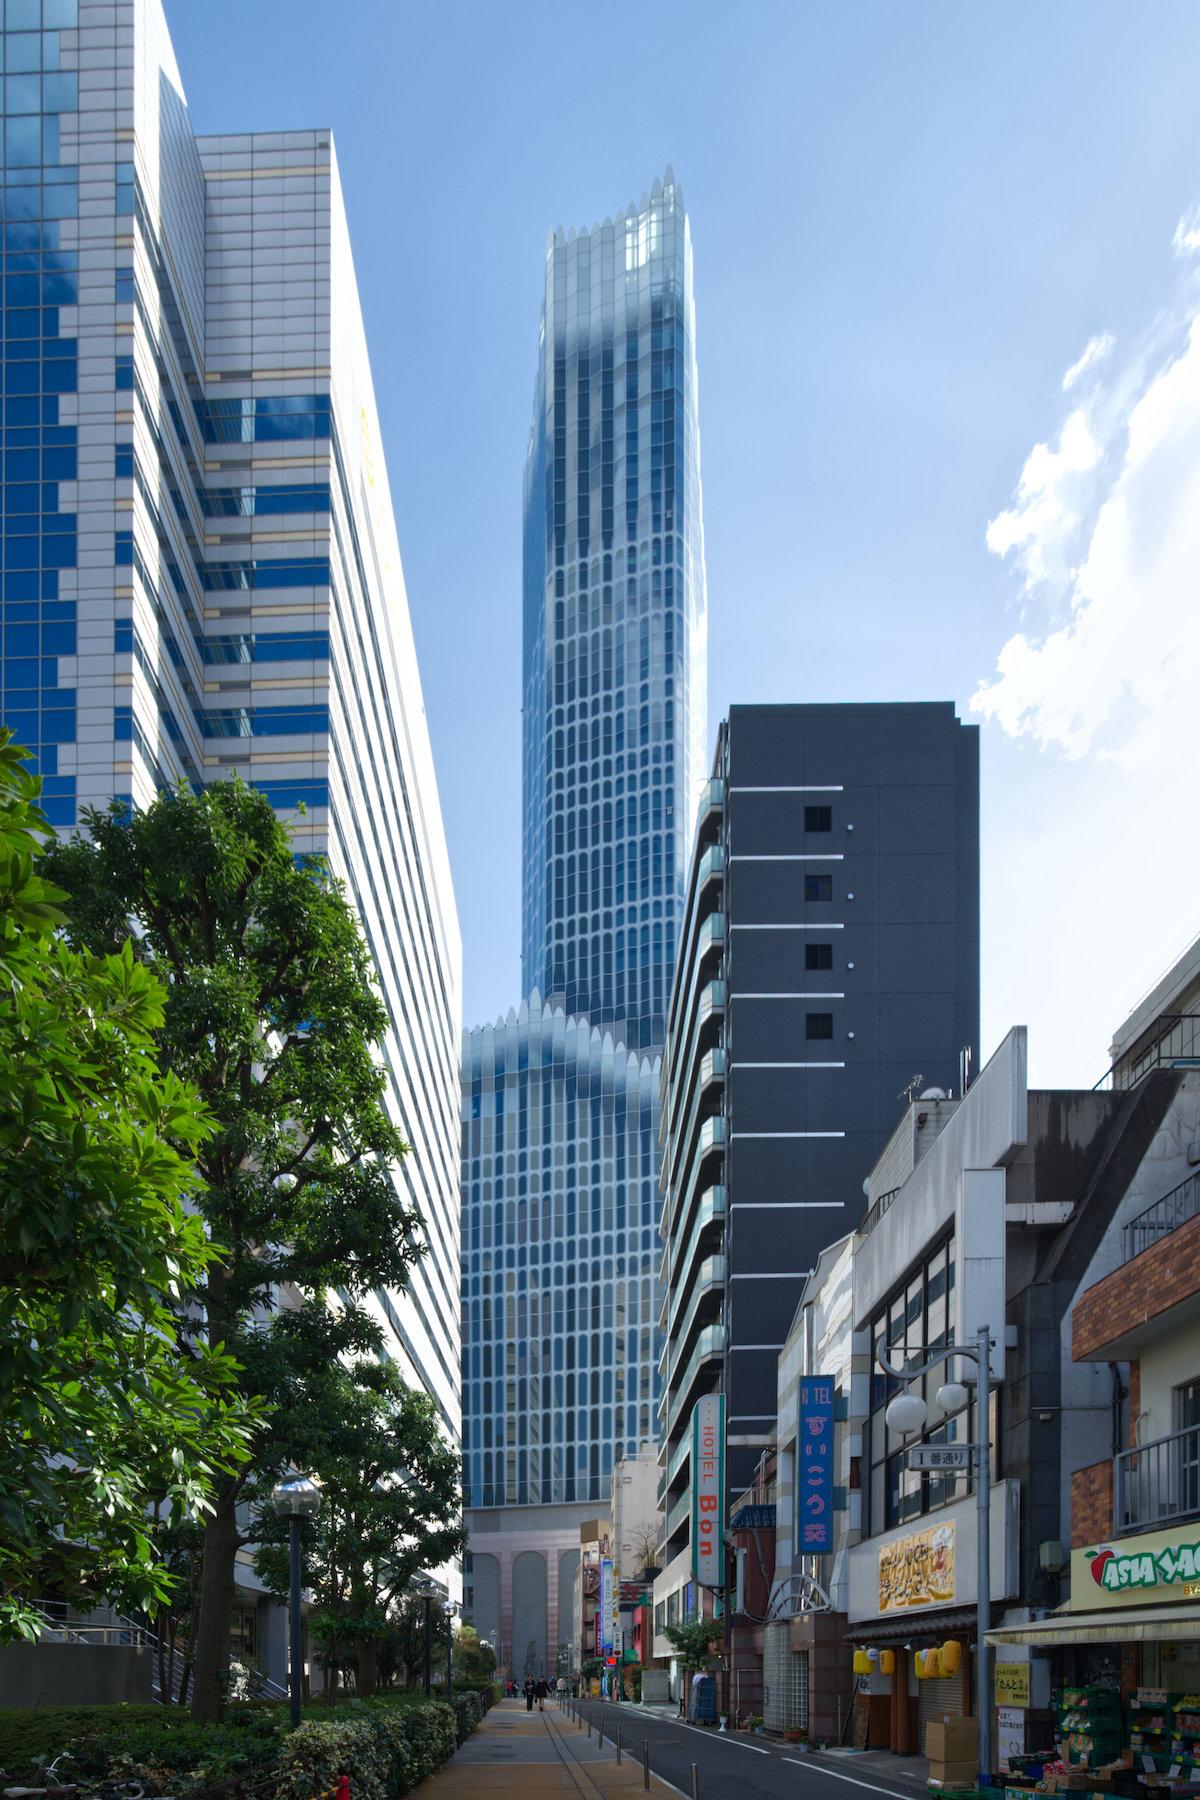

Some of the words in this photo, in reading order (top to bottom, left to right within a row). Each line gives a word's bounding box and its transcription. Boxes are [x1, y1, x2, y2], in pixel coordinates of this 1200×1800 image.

[802, 1387, 832, 1404] HTEL
[703, 1426, 714, 1483] HOTEL
[699, 1495, 717, 1556] Bon
[1103, 1554, 1157, 1590] ASIA
